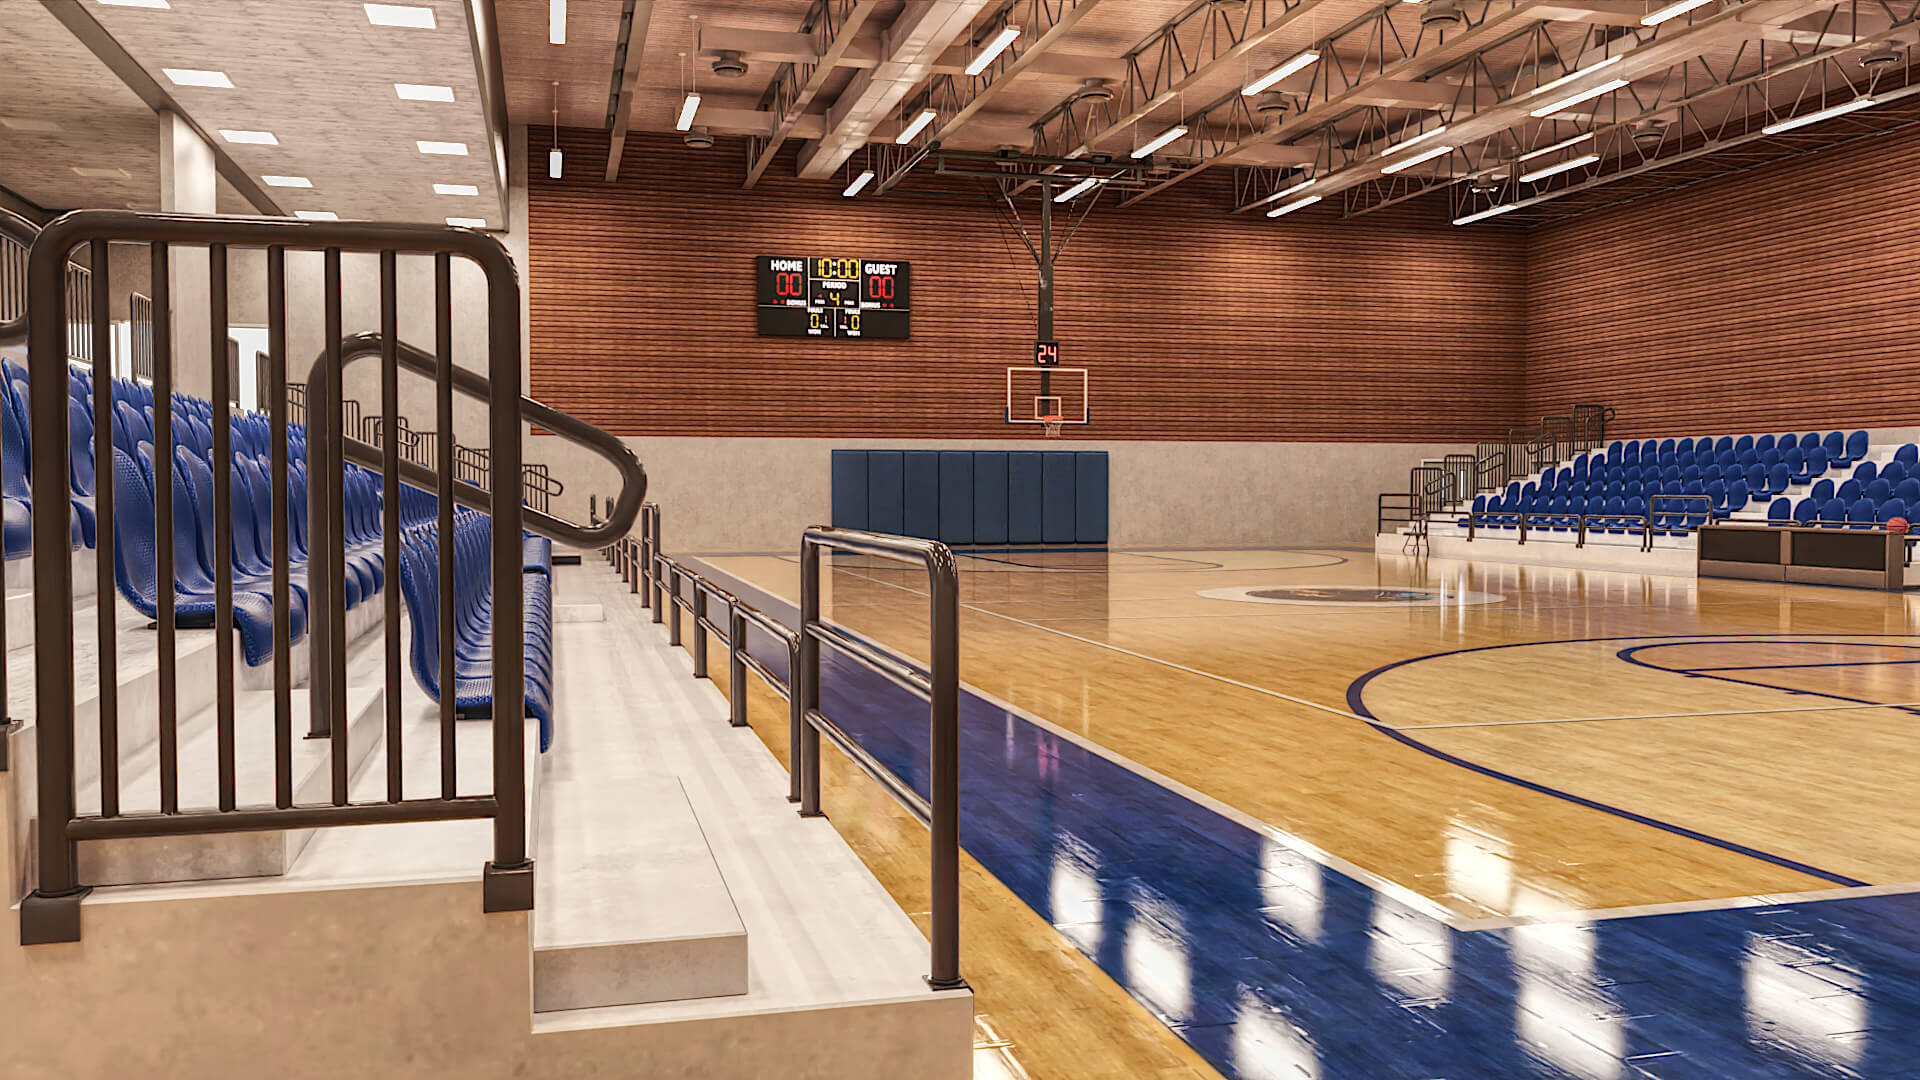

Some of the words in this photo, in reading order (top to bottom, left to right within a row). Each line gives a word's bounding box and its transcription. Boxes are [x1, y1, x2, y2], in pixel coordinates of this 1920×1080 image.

[770, 259, 803, 272] HOME
[818, 258, 859, 279] 10:00
[865, 263, 898, 275] GUEST
[776, 272, 803, 296] 00
[822, 281, 847, 290] PERIOD
[869, 275, 895, 299] 00
[829, 291, 840, 306] 4
[810, 313, 819, 329] 0
[851, 315, 860, 330] 0
[1037, 344, 1057, 364] 24
